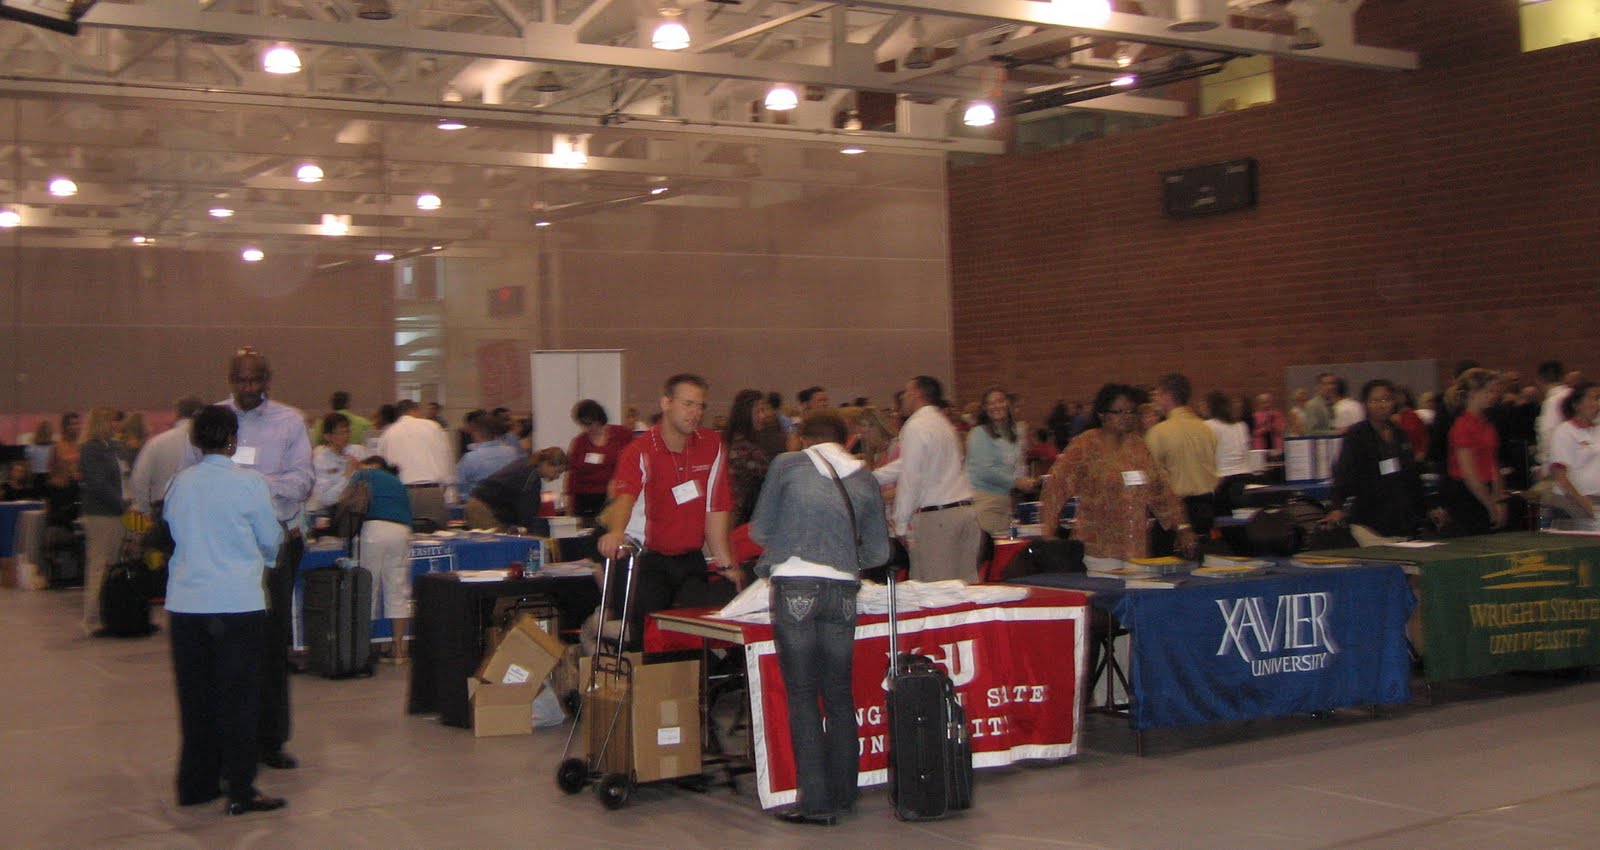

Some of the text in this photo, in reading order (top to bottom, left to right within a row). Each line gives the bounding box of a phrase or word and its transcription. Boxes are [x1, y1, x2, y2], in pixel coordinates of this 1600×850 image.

[408, 546, 443, 557] ERSITY
[1468, 598, 1600, 628] WRIGHT STATE
[1215, 592, 1334, 663] XAVIER
[1489, 628, 1586, 654] UNIVERSITY
[1252, 653, 1327, 677] UNIVERSITY
